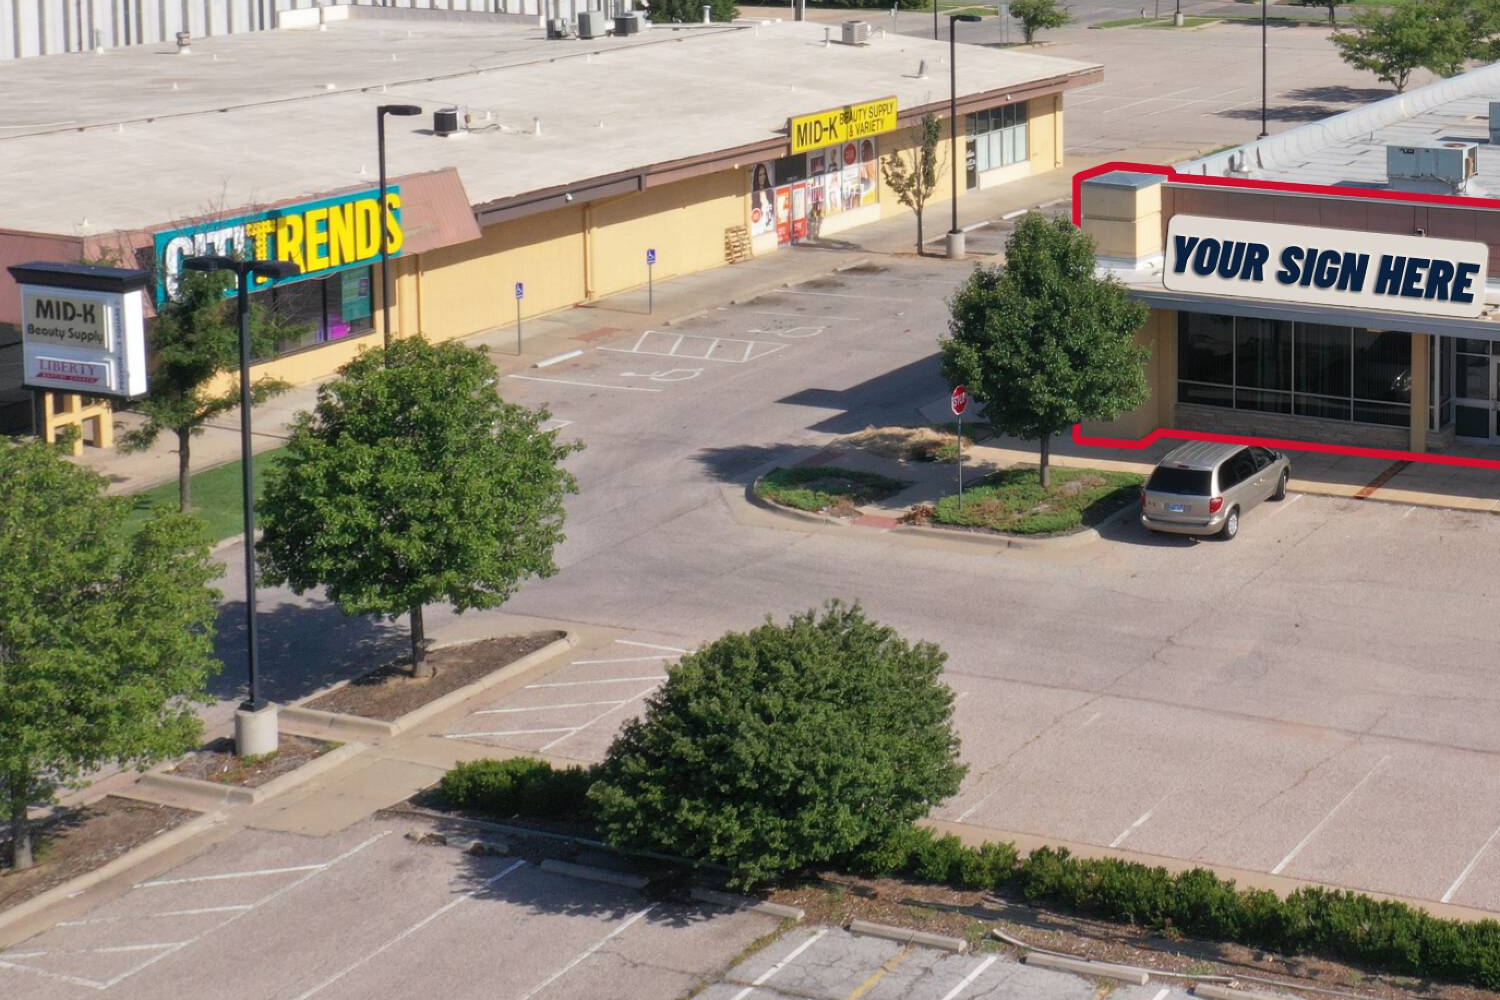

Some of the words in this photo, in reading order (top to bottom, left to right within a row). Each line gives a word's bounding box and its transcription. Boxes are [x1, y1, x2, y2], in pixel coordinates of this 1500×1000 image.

[796, 116, 839, 148] MID-K
[867, 102, 894, 119] SUPPLY
[855, 118, 885, 136] VARIETY
[246, 193, 404, 284] TRENDS
[36, 299, 95, 324] MID-K
[27, 323, 65, 341] Beauty
[68, 327, 104, 343] Supply
[39, 359, 97, 376] LIBERTY
